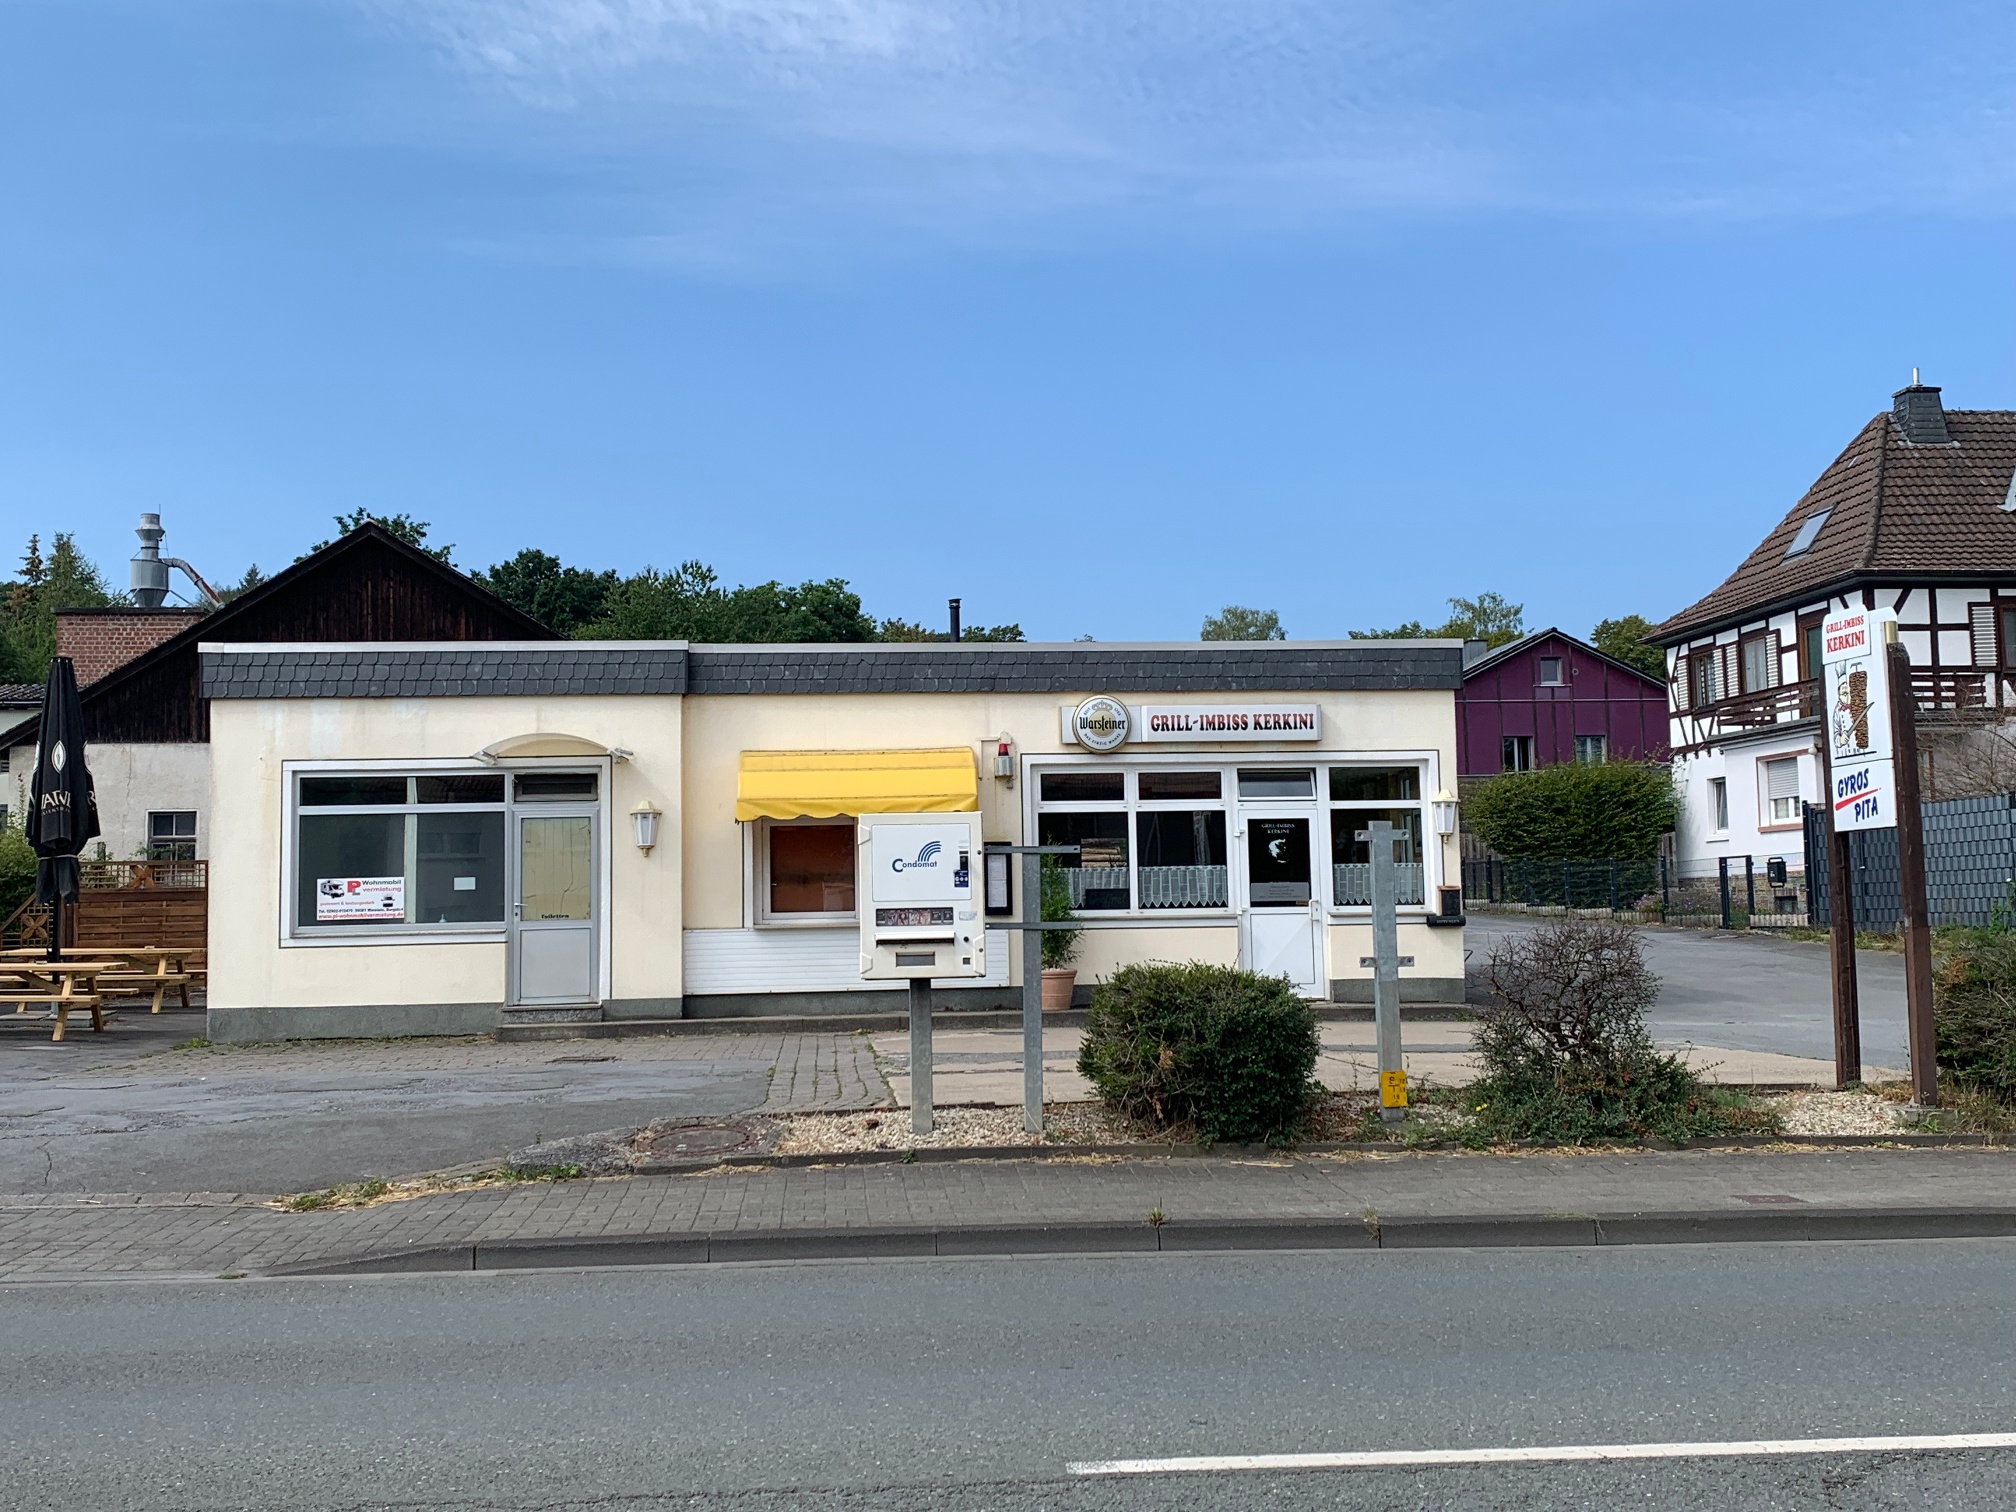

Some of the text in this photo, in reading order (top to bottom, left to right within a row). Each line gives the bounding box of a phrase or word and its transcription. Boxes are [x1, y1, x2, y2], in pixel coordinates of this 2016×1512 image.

[1826, 615, 1864, 634] GRILL-IMBISS
[1827, 630, 1865, 653] KERKINI
[1079, 715, 1126, 731] Warsteiner
[1151, 713, 1314, 731] GRILL-IMBISS KERKINI
[1838, 768, 1869, 798] GYROS
[1854, 796, 1879, 822] PITA
[892, 858, 938, 873] Condomat
